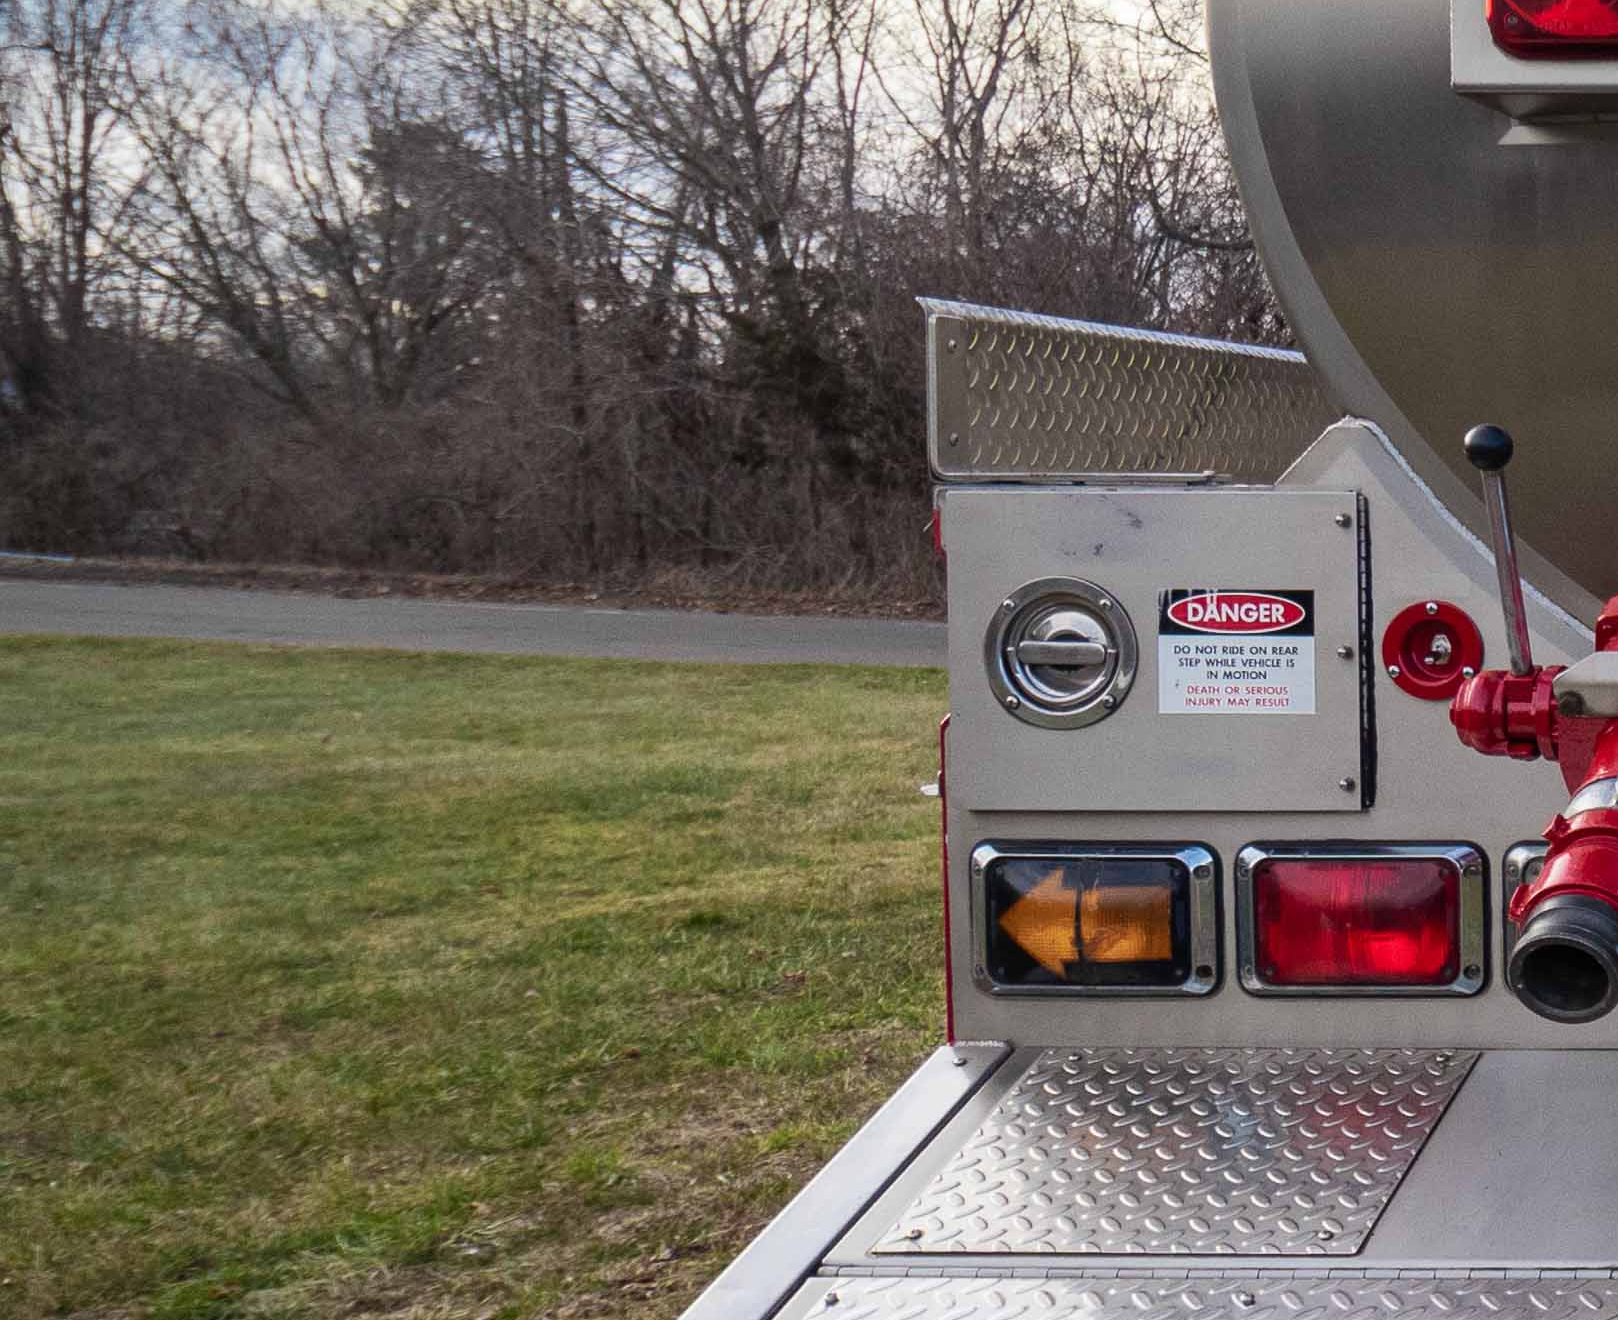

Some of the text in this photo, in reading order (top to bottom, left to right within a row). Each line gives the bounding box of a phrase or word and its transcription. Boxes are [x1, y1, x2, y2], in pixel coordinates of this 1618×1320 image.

[1187, 602, 1285, 623] DANGER
[1174, 645, 1299, 655] DO NOT RIDE ON REAR
[1178, 658, 1295, 668] STEP WHILE VEHICLE IS
[1207, 671, 1267, 680] IN MOTION
[1187, 686, 1288, 695] DEATH OR SERIOUS
[1184, 698, 1290, 707] INJURY MAY RESULT
